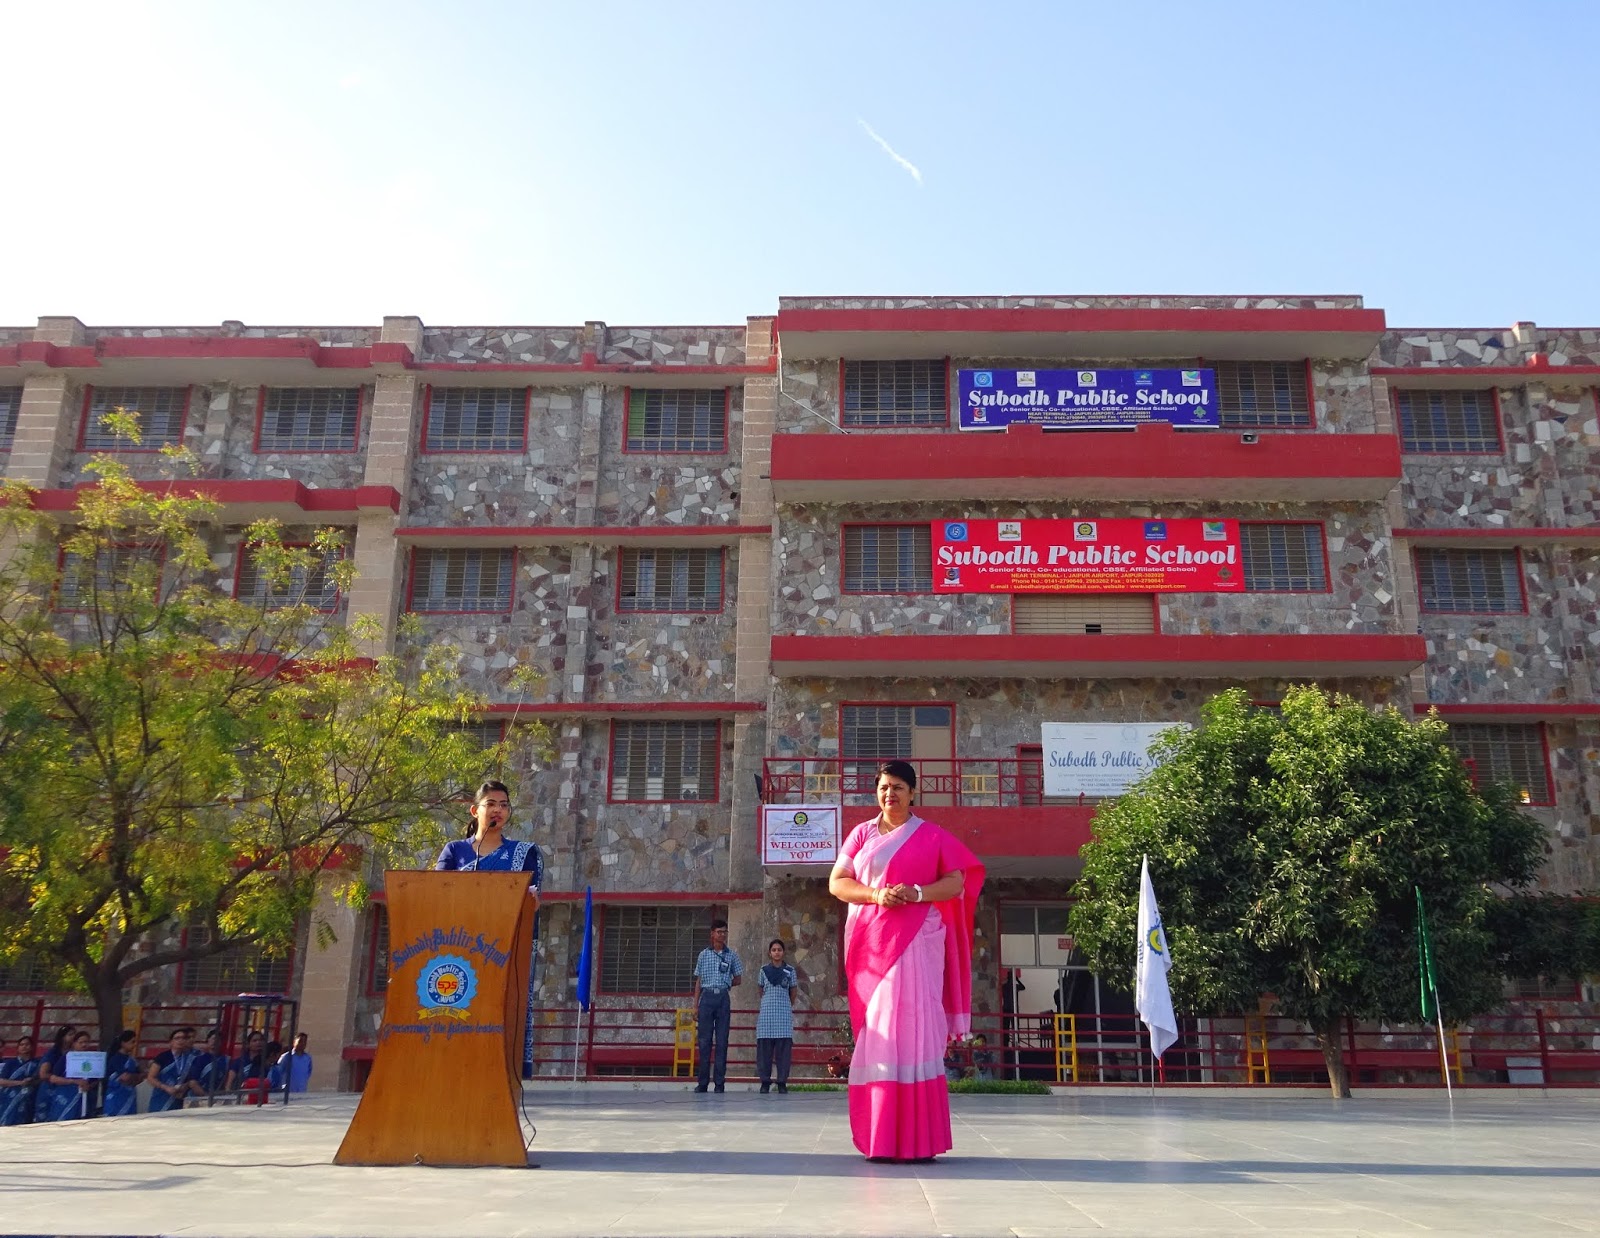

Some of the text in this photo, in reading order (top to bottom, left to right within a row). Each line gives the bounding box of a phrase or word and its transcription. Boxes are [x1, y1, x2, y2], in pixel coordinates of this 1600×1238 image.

[968, 389, 1209, 407] Subodh Public School
[937, 544, 1236, 565] Subodh Public School
[1049, 750, 1097, 767] Subodh
[1101, 750, 1143, 767] Public
[770, 841, 832, 849] WELCOMES
[790, 851, 813, 859] YOU
[432, 927, 472, 953] Public
[470, 934, 511, 968] School
[437, 964, 459, 976] Public
